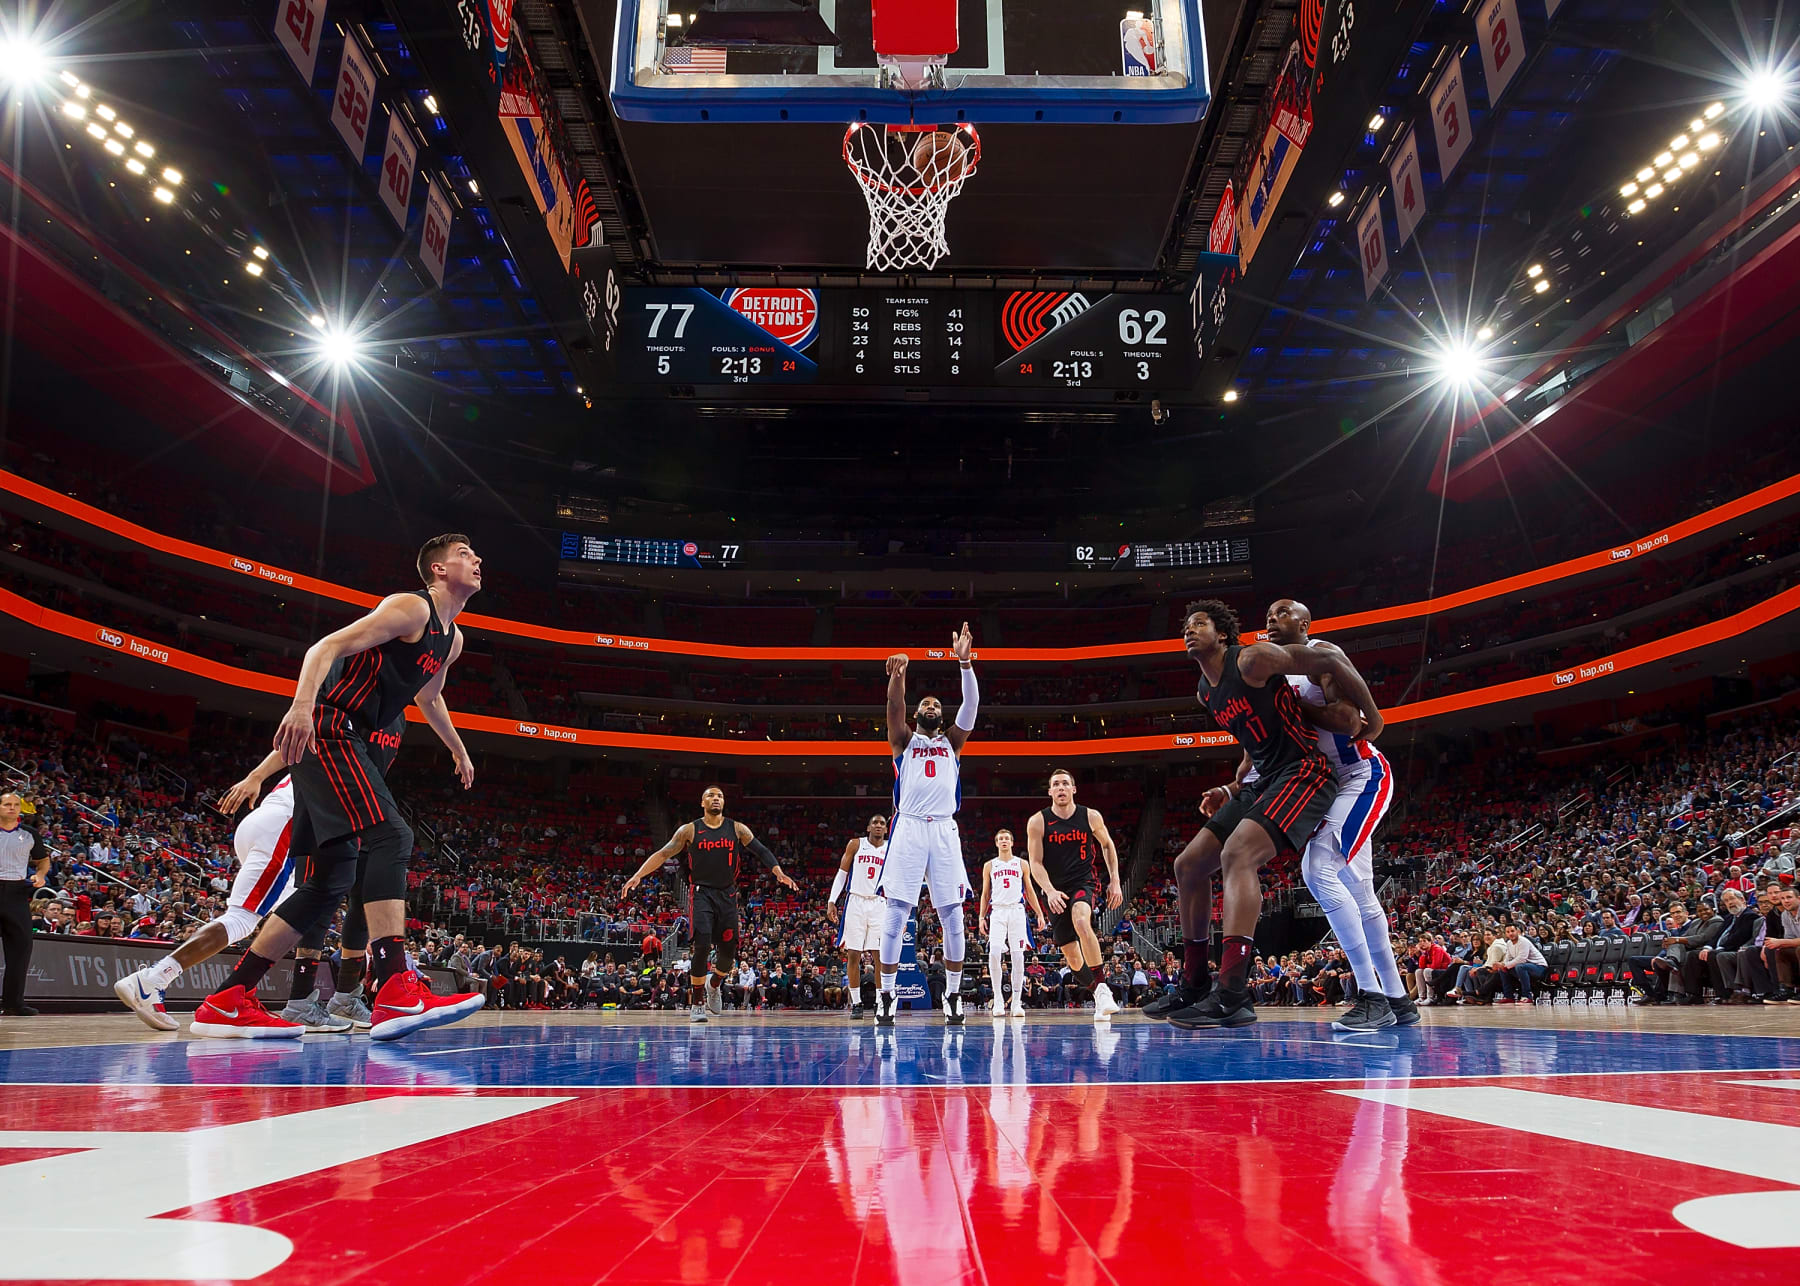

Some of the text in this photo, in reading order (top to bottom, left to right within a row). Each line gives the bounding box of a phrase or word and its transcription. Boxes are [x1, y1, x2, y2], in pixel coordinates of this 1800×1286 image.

[285, 0, 315, 56] 21
[1491, 18, 1511, 73] 2
[1128, 65, 1145, 76] NBA
[338, 70, 368, 142] 32
[1443, 101, 1460, 148] 3
[385, 152, 409, 208] 40
[1402, 173, 1416, 213] 4
[1364, 228, 1382, 279] 10
[606, 268, 620, 327] 62
[742, 296, 804, 311] DETROIT
[645, 303, 695, 338] 77
[741, 311, 804, 326] PISTONS
[852, 307, 962, 318] 50 FG% 41
[852, 321, 964, 332] 34 REBS 30
[1118, 308, 1167, 345] 62
[852, 335, 962, 346] 23 ASTS 14
[856, 349, 960, 360] 4 BLKS 4
[657, 355, 670, 375] 5
[721, 356, 761, 374] 2:13
[782, 360, 796, 371] 24
[855, 364, 960, 375] 6 STLS 8
[1020, 363, 1033, 374] 24
[1053, 361, 1092, 378] 2:13
[1136, 361, 1150, 380] 3
[733, 375, 749, 383] 3rd
[1066, 379, 1081, 387] 3rd
[721, 544, 740, 559] 77
[1076, 546, 1094, 561] 62
[1612, 534, 1669, 559] hap hap.org
[233, 558, 293, 584] hap hap.org
[101, 629, 169, 662] hap hap.org
[597, 635, 649, 649] hap hap.org
[928, 650, 944, 658] hap
[1556, 661, 1614, 685] hap hap.org
[519, 723, 577, 741] hap hap.org
[1245, 715, 1268, 743] 17
[1176, 734, 1233, 746] hap hap.org
[912, 746, 949, 759] PISTONS
[924, 759, 936, 778] 0
[698, 837, 735, 852] ripcity
[1048, 829, 1088, 845] ripcity
[1080, 844, 1087, 860] 5
[858, 855, 885, 866] PISTON
[867, 866, 876, 880] 9
[993, 869, 1019, 880] PISTONS
[1003, 878, 1010, 889] 5
[68, 955, 109, 987] IT'S
